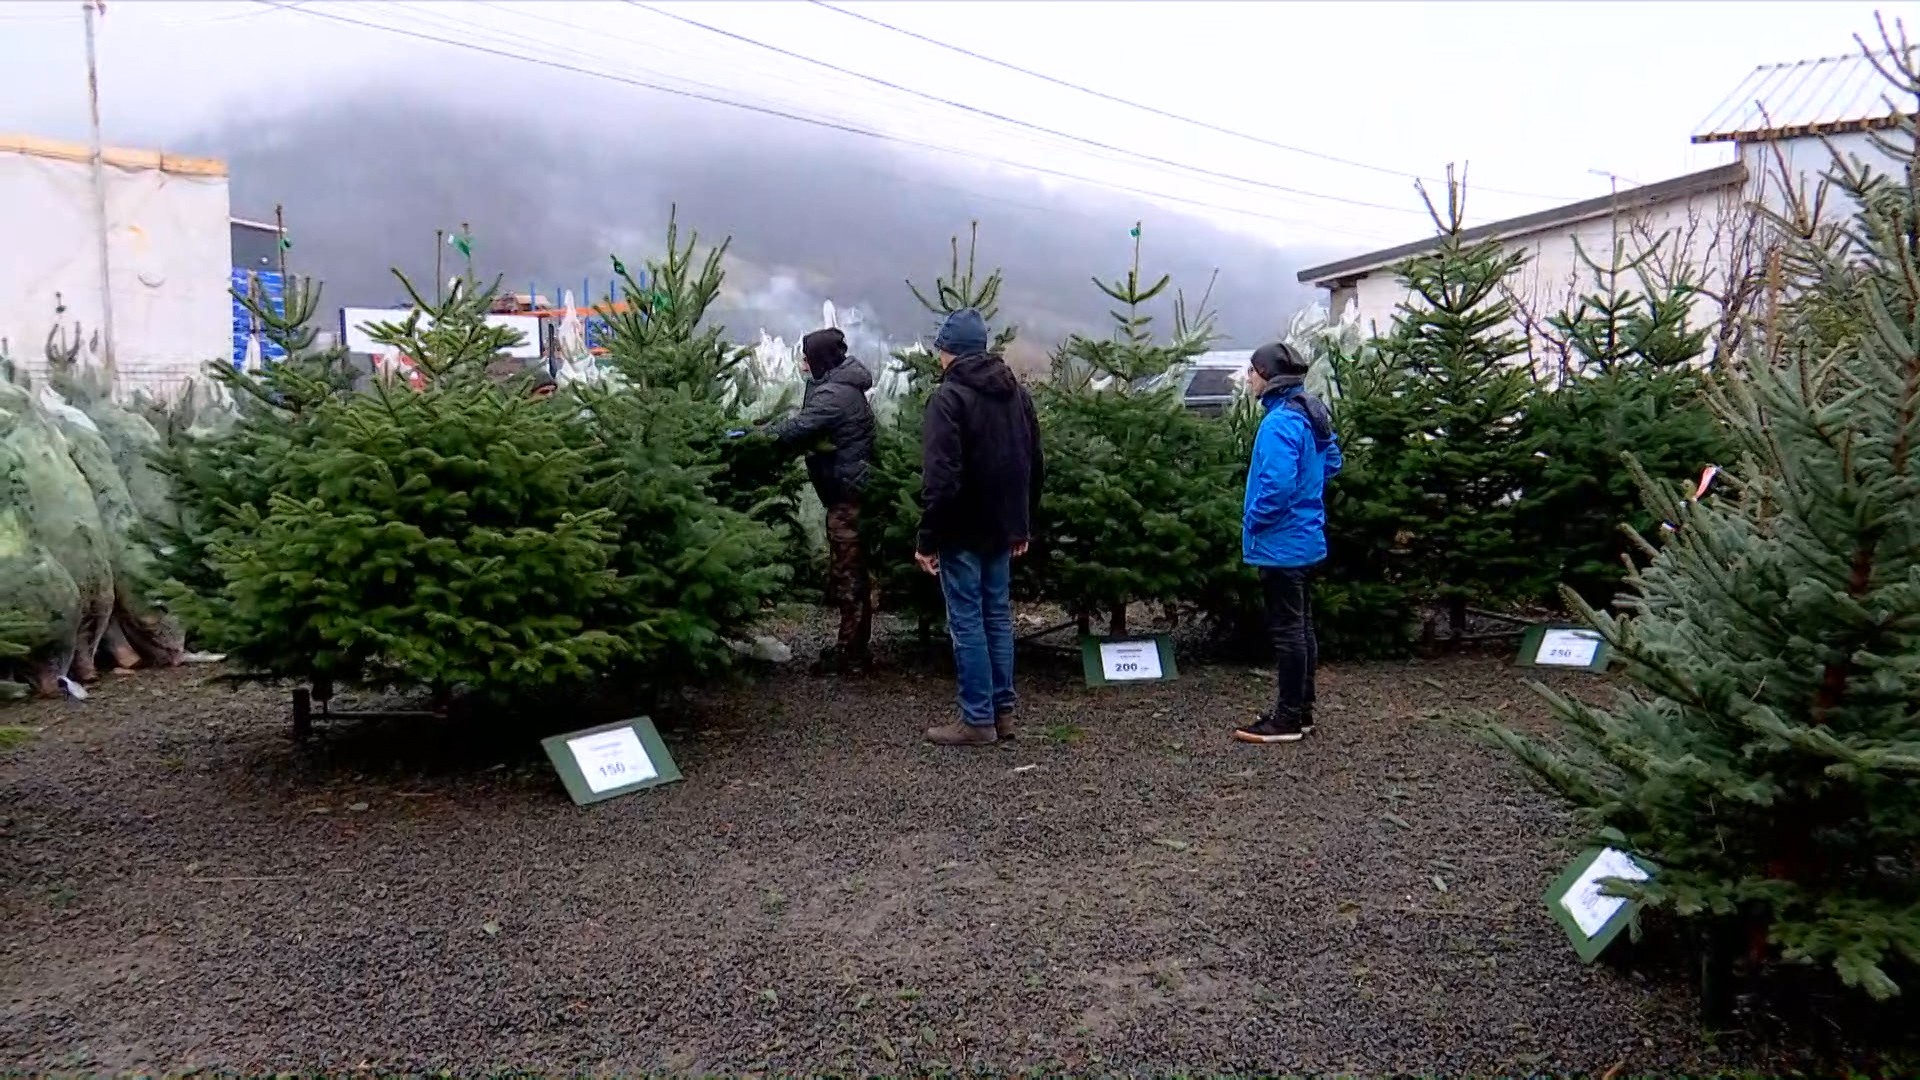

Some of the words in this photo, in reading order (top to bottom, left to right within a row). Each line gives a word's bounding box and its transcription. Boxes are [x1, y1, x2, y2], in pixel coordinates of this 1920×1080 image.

[1550, 649, 1572, 658] 250
[1115, 663, 1138, 672] 200
[599, 762, 626, 778] 150
